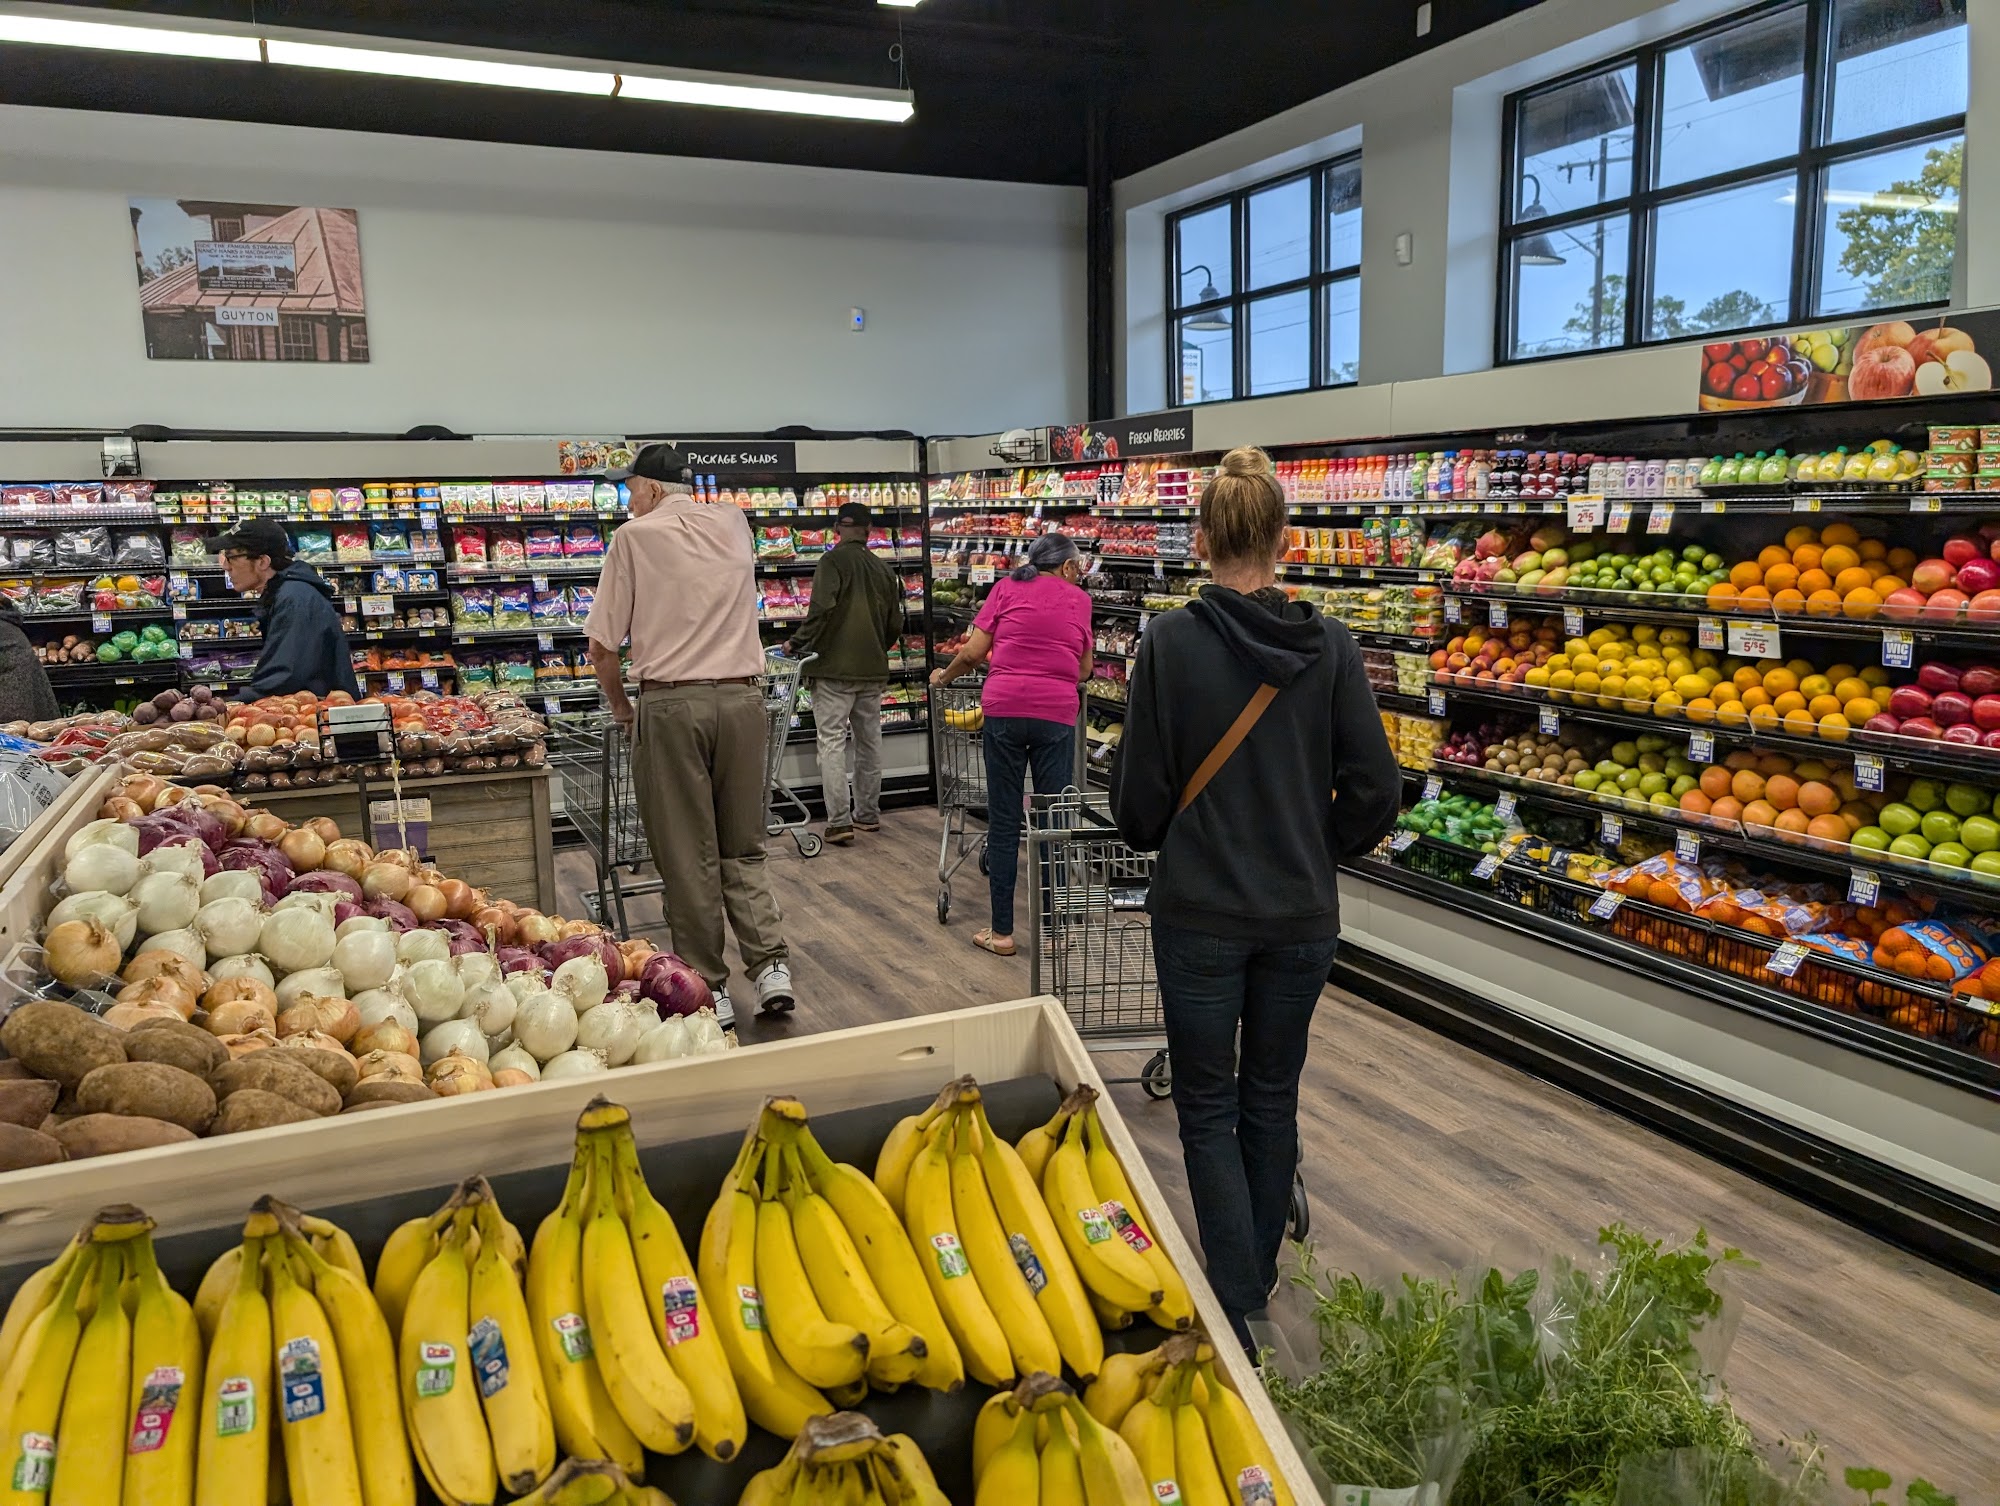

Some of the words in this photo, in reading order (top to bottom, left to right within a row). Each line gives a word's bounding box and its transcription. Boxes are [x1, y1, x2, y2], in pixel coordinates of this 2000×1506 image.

[221, 311, 274, 322] GUYTON
[1129, 431, 1153, 445] FRESH
[1153, 427, 1186, 442] BERRIES
[687, 452, 738, 465] PACKAGE
[739, 452, 779, 464] SALADS
[1446, 606, 1459, 615] WIC
[1491, 610, 1505, 620] WIC
[1566, 616, 1580, 626] WIC
[1743, 641, 1766, 654] 5/$5
[1886, 642, 1909, 655] WIC
[1430, 696, 1444, 706] WIC
[1541, 715, 1557, 726] WIC
[1691, 740, 1710, 752] WIC
[1857, 765, 1880, 780] WIC
[1604, 822, 1619, 835] WIC
[1678, 840, 1697, 852] WIC
[1853, 879, 1875, 894] WIC
[1598, 898, 1615, 910] WIC
[669, 1277, 689, 1288] 125
[426, 1345, 451, 1358] Dole
[1242, 1466, 1262, 1479] 125
[1157, 1481, 1176, 1496] Dole
